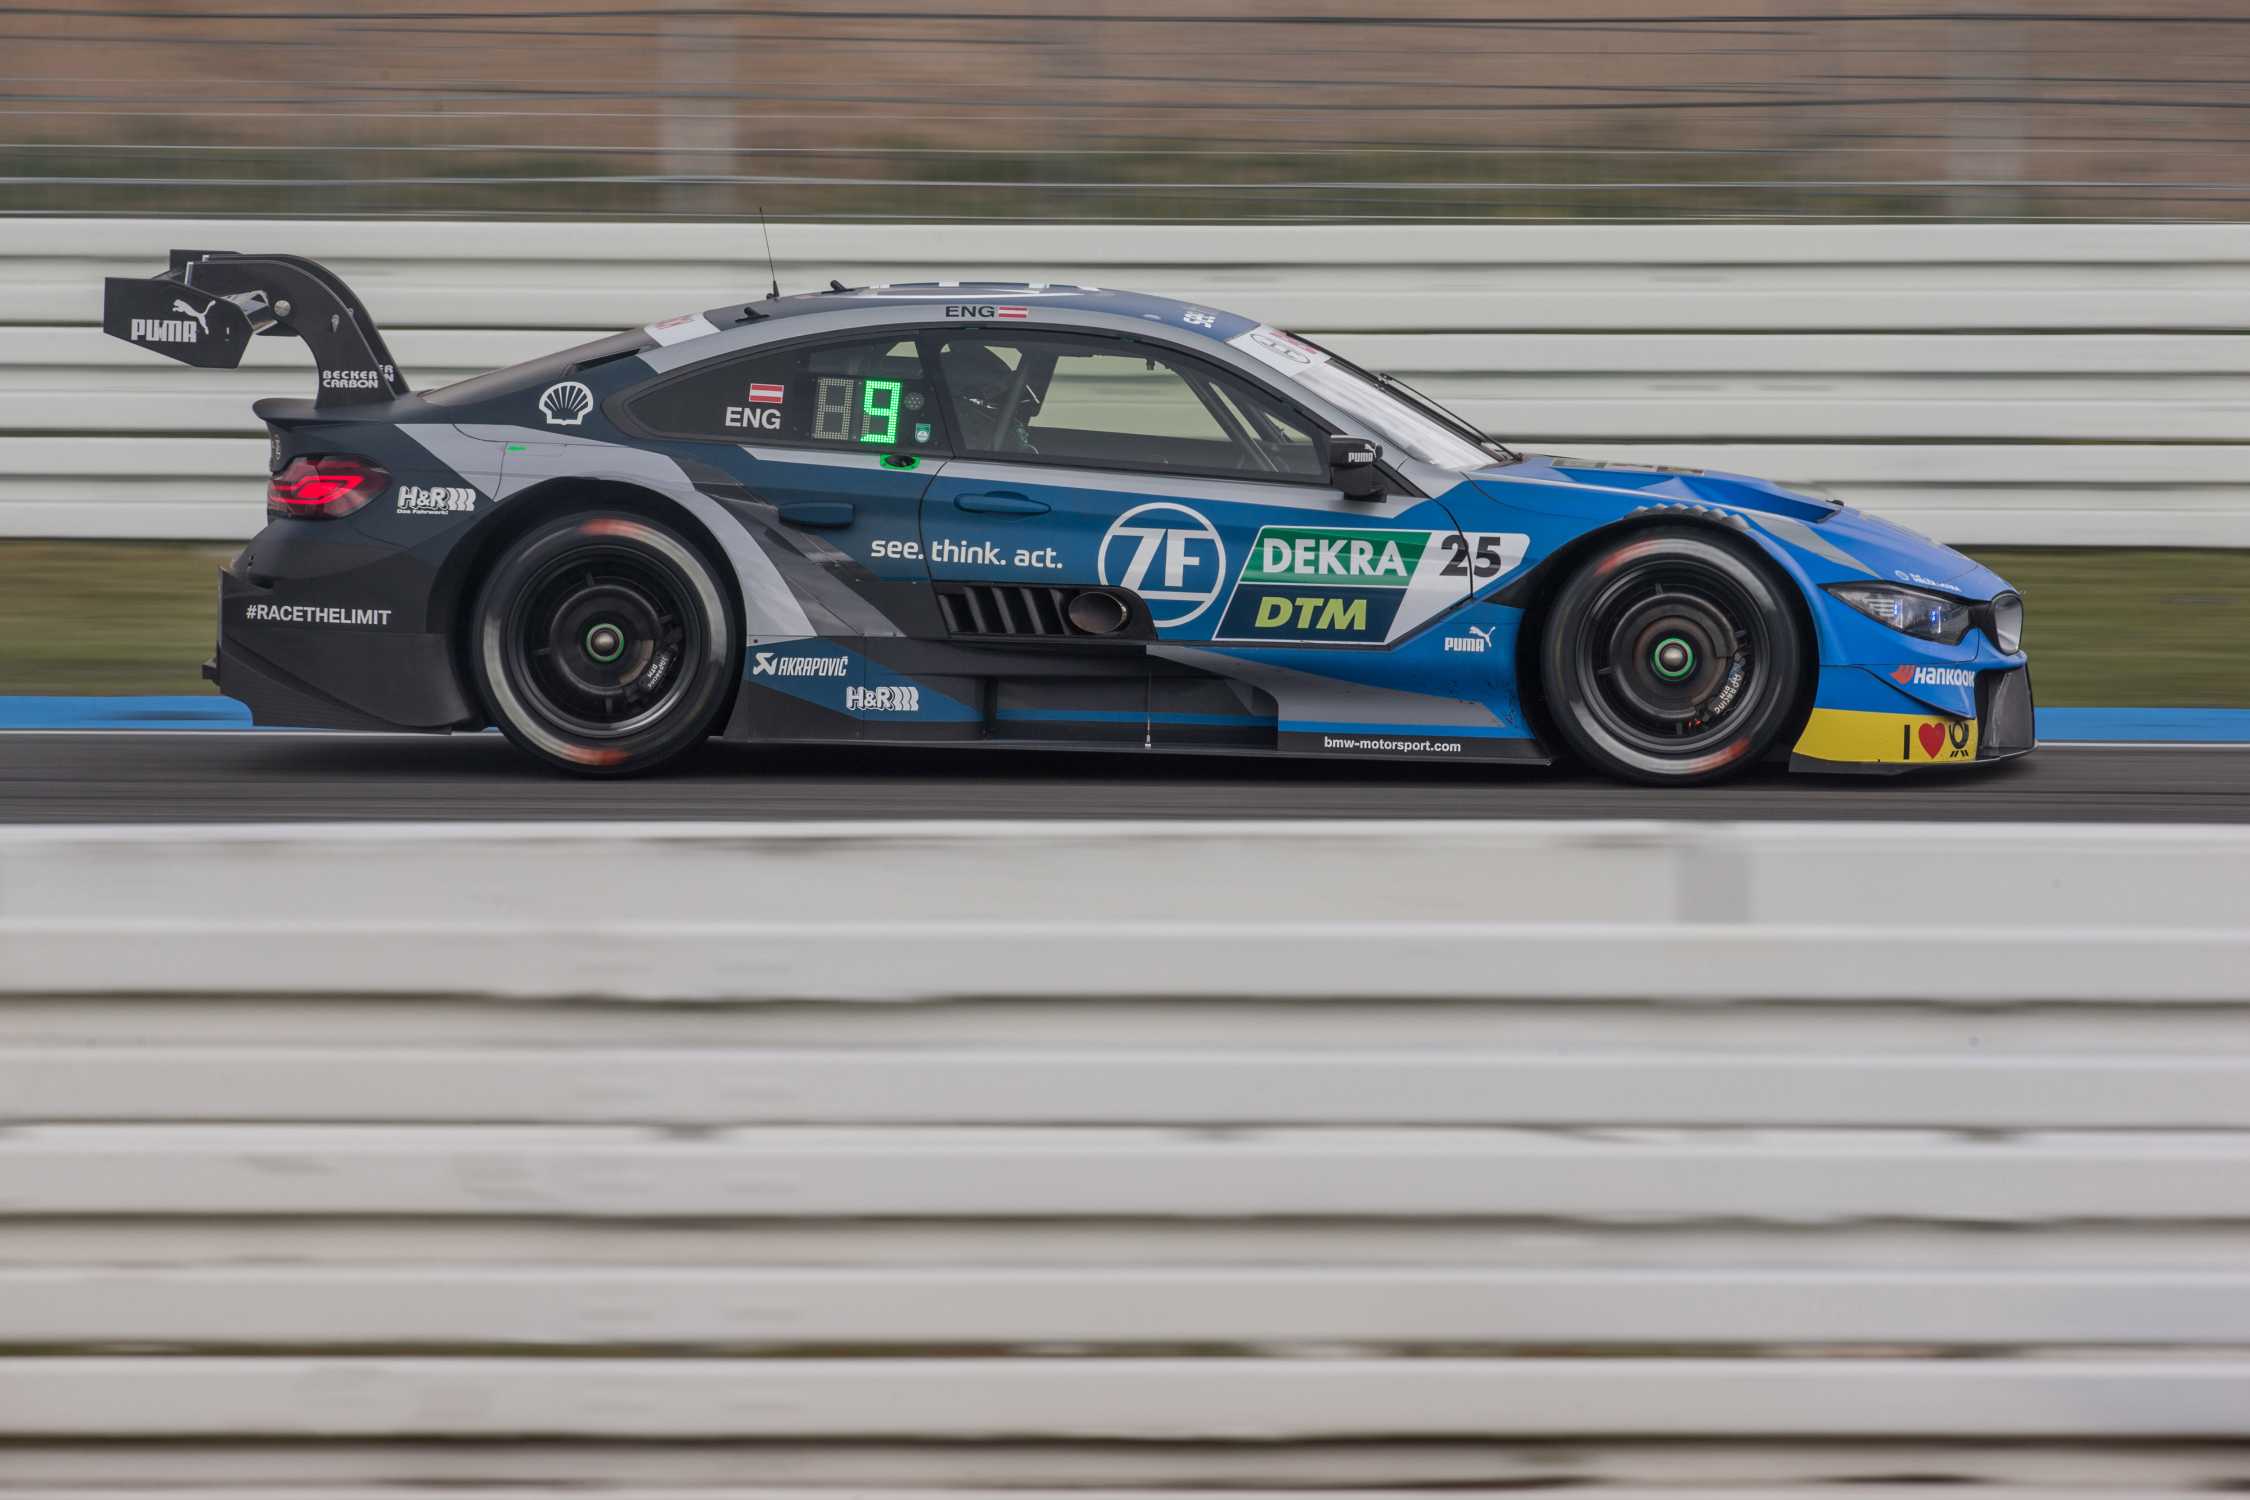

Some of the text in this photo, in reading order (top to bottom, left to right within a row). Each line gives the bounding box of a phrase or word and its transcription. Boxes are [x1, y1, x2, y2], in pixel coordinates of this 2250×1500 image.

[946, 306, 995, 318] ENG
[131, 319, 196, 342] PUMA
[323, 370, 377, 379] BECKER
[323, 379, 378, 388] CARBON
[725, 406, 781, 430] ENG
[861, 380, 901, 444] 9
[1348, 452, 1373, 463] PUMA
[397, 485, 449, 510] H&R
[871, 539, 1063, 568] see. think. act.
[1263, 538, 1408, 577] DEKRA
[1440, 535, 1502, 577] 25
[246, 604, 392, 625] #RACETHELIMIT
[1254, 596, 1367, 631] DTM
[1444, 637, 1485, 653] PUMA
[846, 686, 896, 711] H&R
[1324, 736, 1461, 752] bmw-motorsport.com
